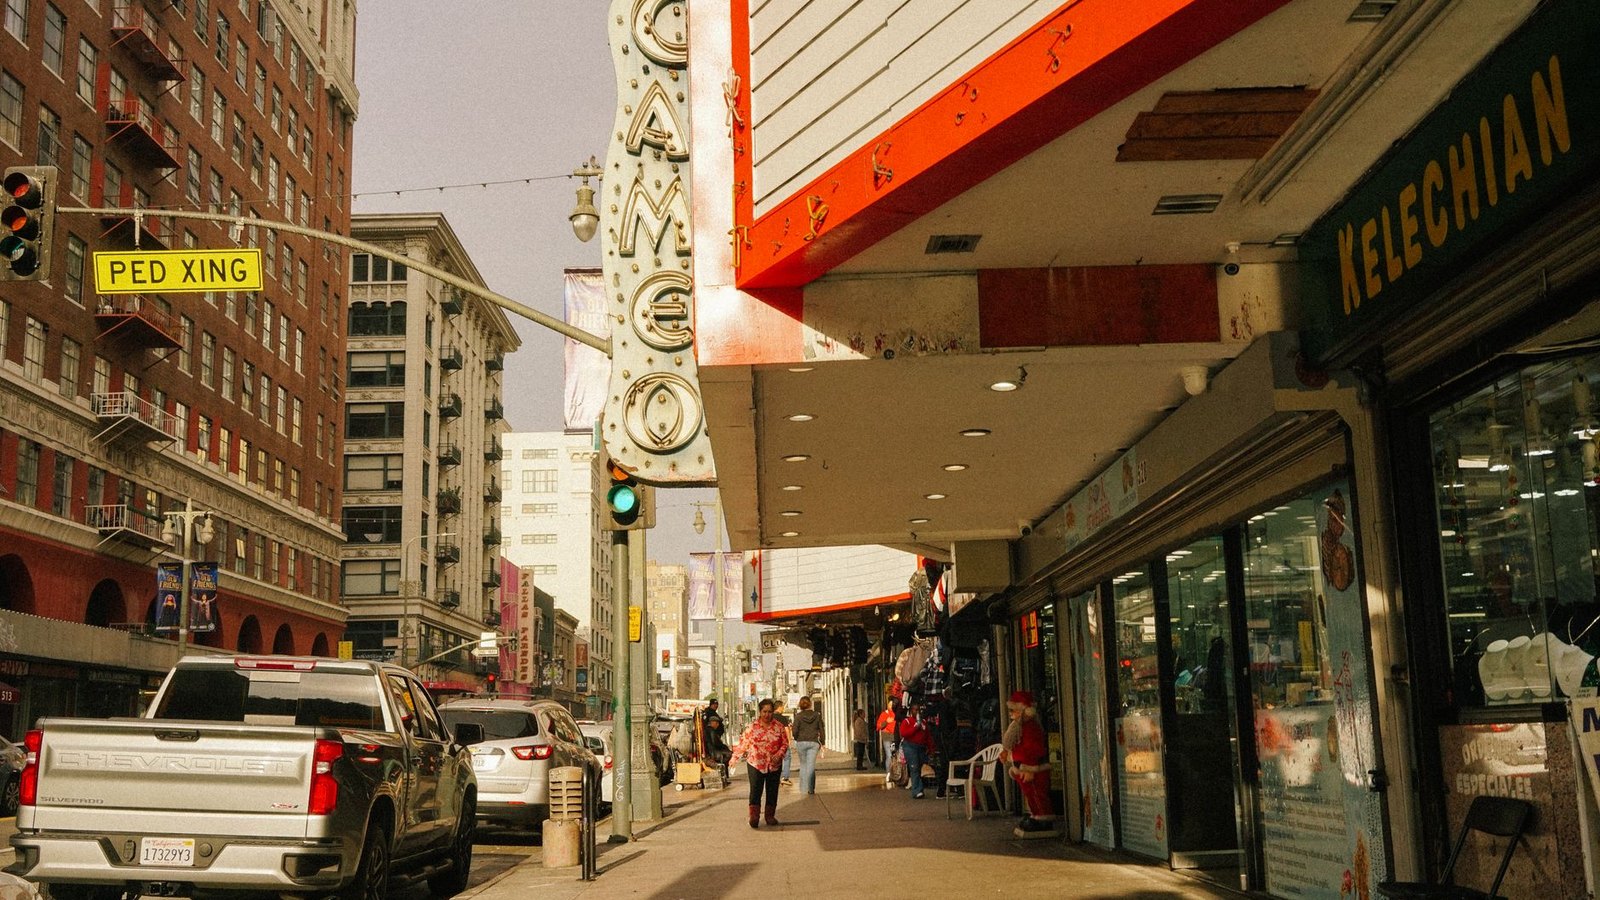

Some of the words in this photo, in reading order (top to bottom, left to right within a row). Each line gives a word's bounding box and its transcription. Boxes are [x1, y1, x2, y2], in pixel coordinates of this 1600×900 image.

[1338, 55, 1571, 316] KELECHIAN
[111, 260, 166, 284] PED
[181, 258, 248, 283] XING
[1, 690, 13, 702] 513
[57, 752, 294, 775] CHEVROLET
[40, 796, 104, 805] SILVERADO
[143, 847, 191, 862] 17329Y3
